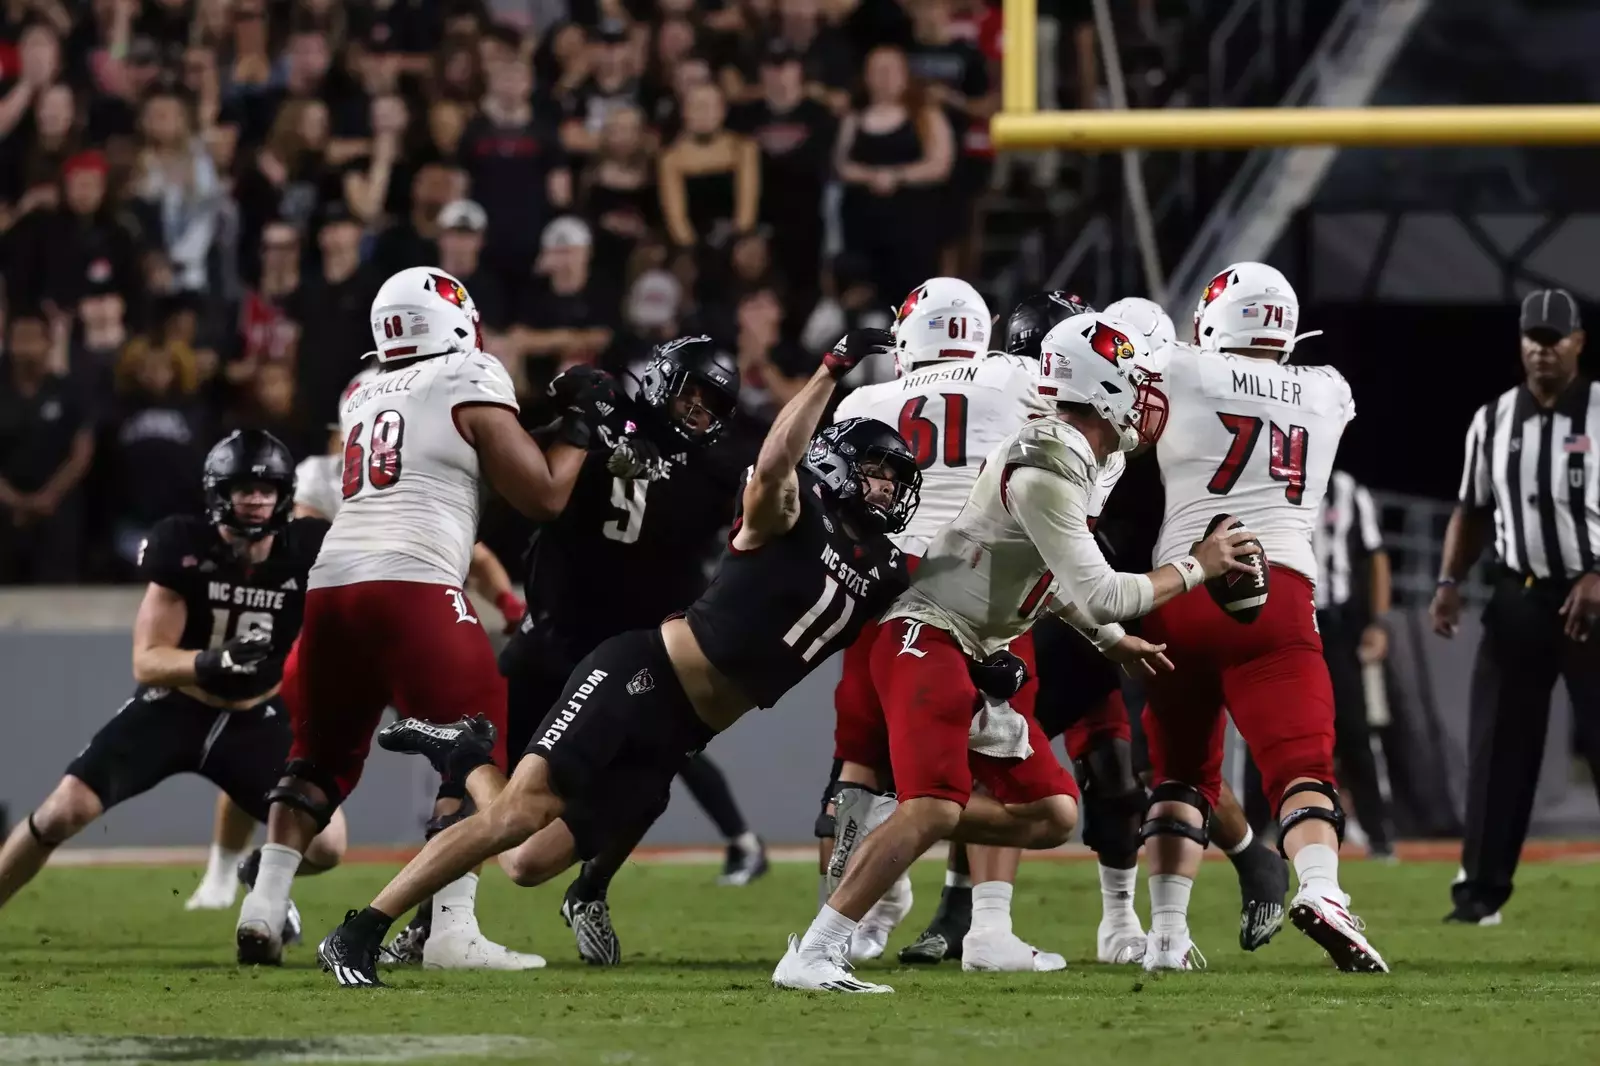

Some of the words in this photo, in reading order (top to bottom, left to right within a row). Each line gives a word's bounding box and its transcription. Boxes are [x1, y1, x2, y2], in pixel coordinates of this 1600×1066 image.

[384, 315, 404, 338] 68
[948, 316, 967, 339] 61
[1263, 304, 1283, 328] 74
[903, 367, 978, 391] HUDSON
[1232, 369, 1301, 405] MILLER
[898, 393, 969, 470] 61
[342, 409, 405, 500] 68
[1207, 411, 1309, 506] 74
[1569, 468, 1584, 488] U
[820, 543, 840, 571] NC
[837, 562, 870, 597] STATE
[208, 581, 231, 602] NC
[233, 586, 286, 609] STATE
[445, 588, 478, 625] L
[782, 574, 855, 663] 11
[897, 618, 928, 658] L
[536, 668, 608, 751] WOLFPACK
